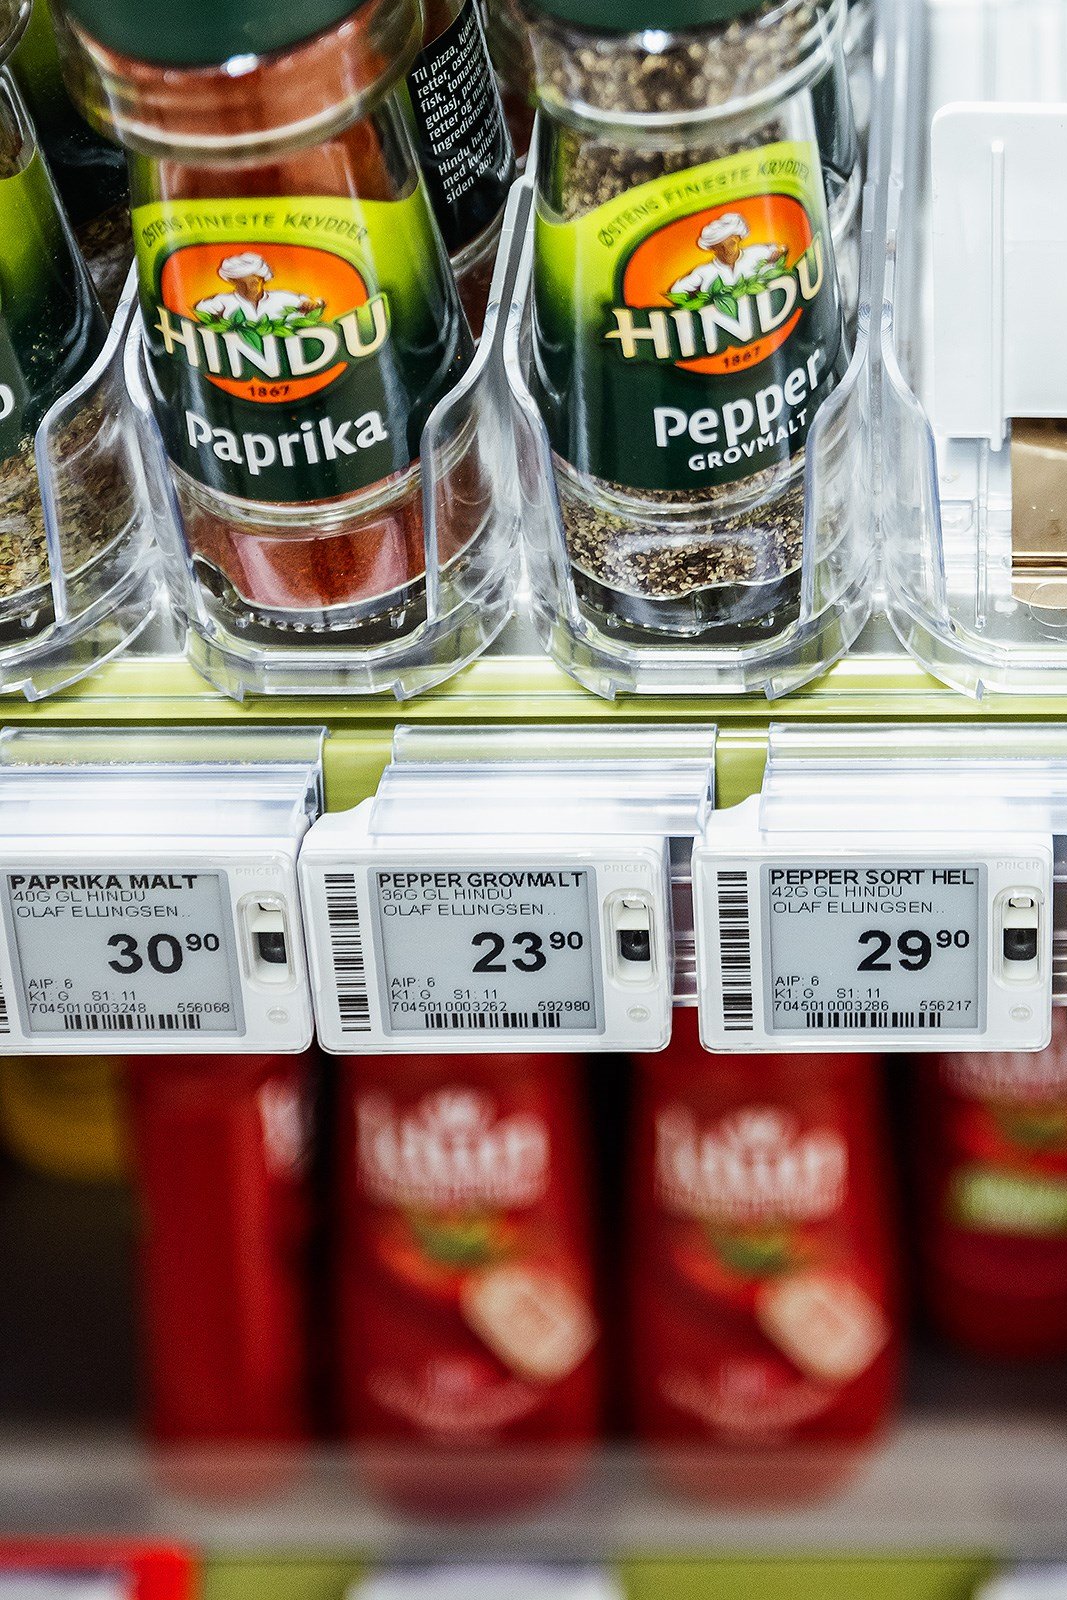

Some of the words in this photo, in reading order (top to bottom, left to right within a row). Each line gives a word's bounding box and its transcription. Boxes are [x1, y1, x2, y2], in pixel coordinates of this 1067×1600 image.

[411, 65, 428, 84] Til
[430, 45, 459, 76] pizza,
[417, 69, 451, 99] retter,
[420, 92, 446, 113] fisk,
[425, 94, 460, 131] gulasj,
[429, 111, 459, 142] retter
[460, 97, 472, 116] og
[437, 144, 470, 176] Hindu
[470, 126, 484, 148] har
[442, 163, 467, 190] med
[446, 176, 475, 205] siden
[475, 152, 494, 177] 1867.
[663, 165, 752, 208] FINESTE
[183, 212, 277, 231] FINESTE
[282, 212, 369, 245] KRYDDER
[604, 232, 825, 360] HINDU
[154, 294, 389, 379] HINDU
[248, 384, 291, 399] 1867
[652, 348, 829, 448] Pepper
[185, 409, 389, 477] Paprika
[687, 407, 809, 473] GROVMALT
[10, 875, 122, 890] PAPRIKA
[129, 875, 198, 890] MALT
[378, 872, 463, 889] PEPPER
[466, 872, 583, 889] GROVMALT
[770, 869, 859, 886] PEPPER
[865, 869, 925, 886] SORT
[931, 869, 975, 886] HEL
[12, 890, 50, 903] 40G
[55, 890, 82, 903] GL
[87, 890, 147, 903] HINDU
[381, 888, 418, 901] 36G
[422, 888, 450, 901] GL
[453, 888, 514, 901] HINDU
[772, 886, 809, 899] 42G
[813, 886, 840, 899] GL
[844, 886, 904, 899] HINDU
[16, 905, 66, 919] OLAF
[383, 903, 432, 917] OLAF
[772, 901, 822, 915] OLAF
[107, 932, 184, 975] 30
[185, 933, 221, 952] 90
[470, 931, 548, 974] 23
[549, 931, 584, 950] 90
[856, 929, 933, 973] 29
[935, 929, 971, 949] 90
[426, 977, 436, 988] 6
[810, 975, 820, 987] 6
[803, 988, 815, 999] G
[866, 988, 881, 999] 11
[29, 1002, 147, 1014] 7045010003248
[176, 1002, 231, 1014] 556068
[391, 1001, 507, 1013] 7045010003262
[537, 1000, 591, 1012] 592980
[774, 1000, 890, 1012] 7045010003286
[919, 1000, 972, 1012] 556217
